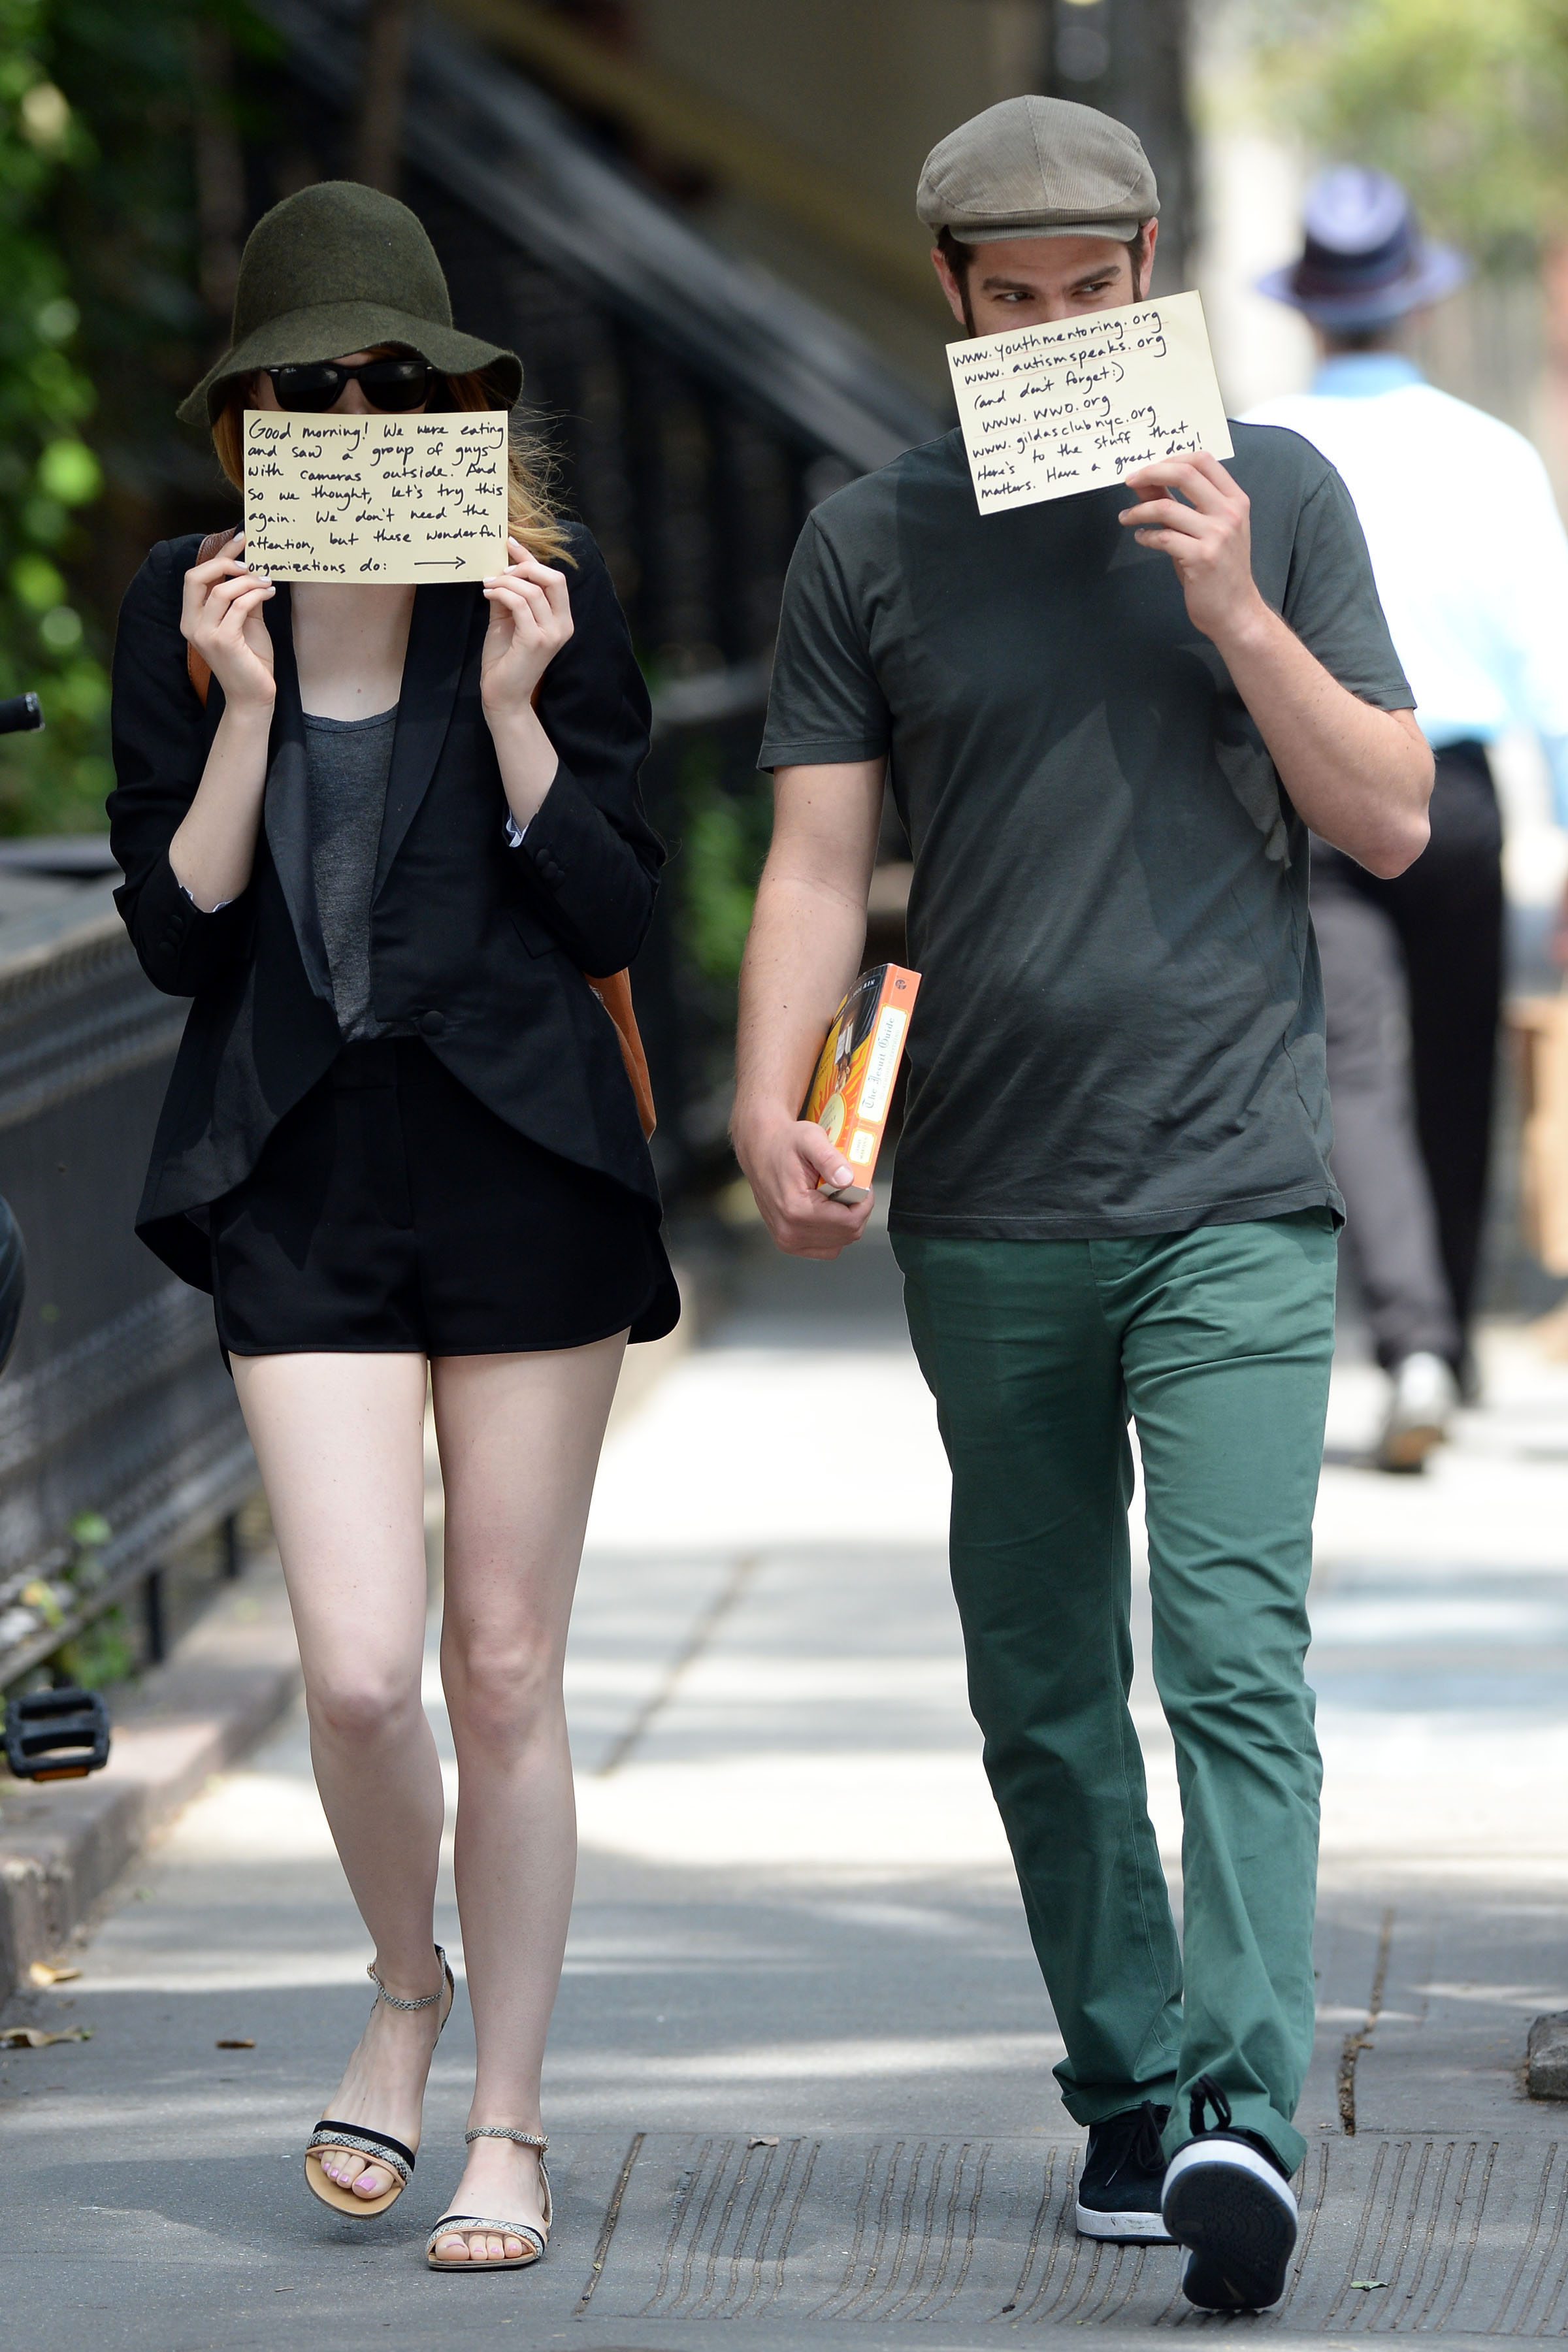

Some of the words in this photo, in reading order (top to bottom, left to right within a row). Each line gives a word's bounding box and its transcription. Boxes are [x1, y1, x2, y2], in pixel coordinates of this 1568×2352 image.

[1019, 376, 1054, 398] don't
[249, 418, 291, 440] Good
[302, 422, 368, 451] morning!
[384, 423, 404, 436] We
[417, 425, 449, 435] were
[461, 422, 504, 449] eating
[248, 446, 277, 457] and
[292, 445, 322, 457] saw
[342, 451, 353, 461] a
[370, 444, 414, 466] group
[427, 442, 443, 455] of
[451, 445, 489, 466] guys
[977, 461, 1015, 482] Here's
[1032, 448, 1045, 463] to
[1057, 442, 1082, 456] the
[1149, 420, 1189, 439] that
[248, 463, 284, 477] with
[301, 470, 361, 482] cameras
[383, 466, 453, 480] outside.
[466, 463, 496, 477] And
[981, 483, 1036, 499] matters.
[1047, 466, 1080, 483] Have
[1115, 449, 1156, 474] great
[1166, 432, 1203, 455] day!
[279, 491, 300, 500] we
[312, 485, 372, 511] thought,
[437, 483, 464, 506] try
[476, 483, 503, 497] this
[249, 513, 295, 532] again.
[316, 512, 337, 523] We
[355, 508, 394, 523] don't
[410, 508, 447, 519] need
[463, 504, 489, 516] the
[248, 536, 315, 555] attention,
[329, 532, 359, 546] but
[373, 529, 412, 543] these
[426, 525, 502, 541] wonderful
[248, 561, 346, 576] organizations
[359, 558, 387, 572] do:
[862, 1088, 877, 1108] The
[878, 1018, 894, 1048] Guide
